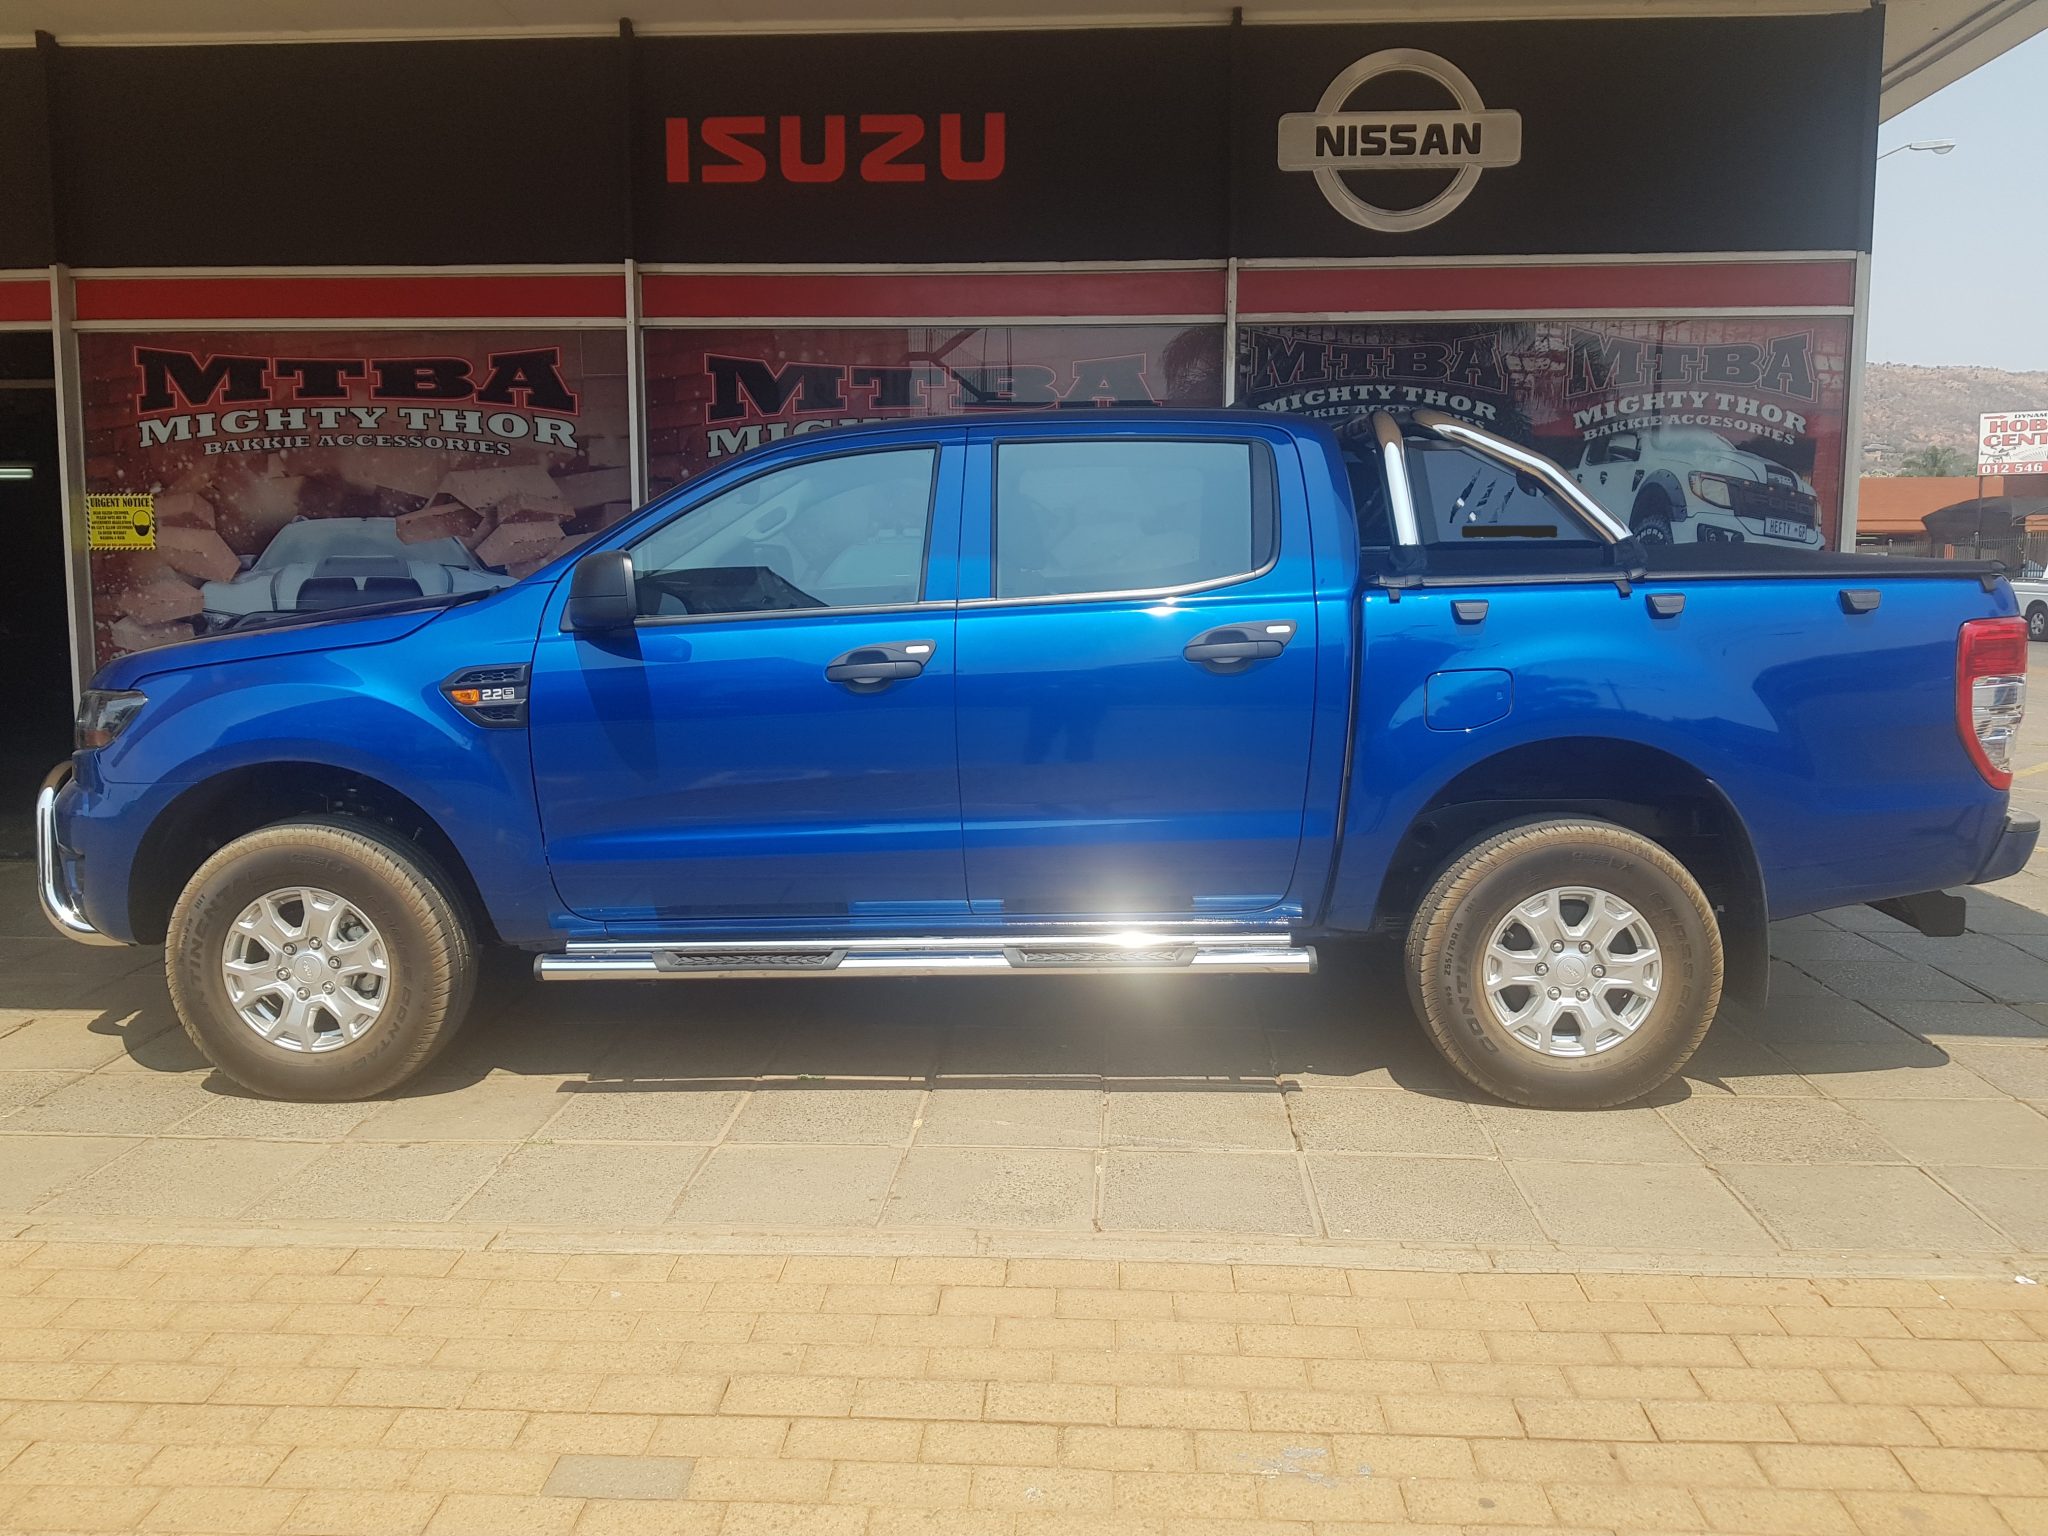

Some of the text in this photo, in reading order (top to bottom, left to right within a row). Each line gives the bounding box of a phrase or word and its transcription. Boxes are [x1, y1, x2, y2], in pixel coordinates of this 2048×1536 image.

[665, 112, 1006, 183] ISUZU
[1315, 122, 1482, 157] NISSAN
[134, 345, 579, 416] MTBA
[1246, 328, 1511, 395] MTBA
[1563, 323, 1819, 403] MTBA
[704, 352, 1162, 424] MTBA
[1257, 384, 1498, 421] MIGHTY THOR
[138, 406, 578, 449] MIGHTY THOR
[1573, 391, 1807, 434] MIGHTY THOR
[1583, 414, 1796, 446] BAKKIE ACCESORIES
[203, 434, 512, 456] BAKKIE ACCESSORIES
[1981, 462, 2043, 474] 012 546
[90, 497, 150, 508] URGENT NOTICE
